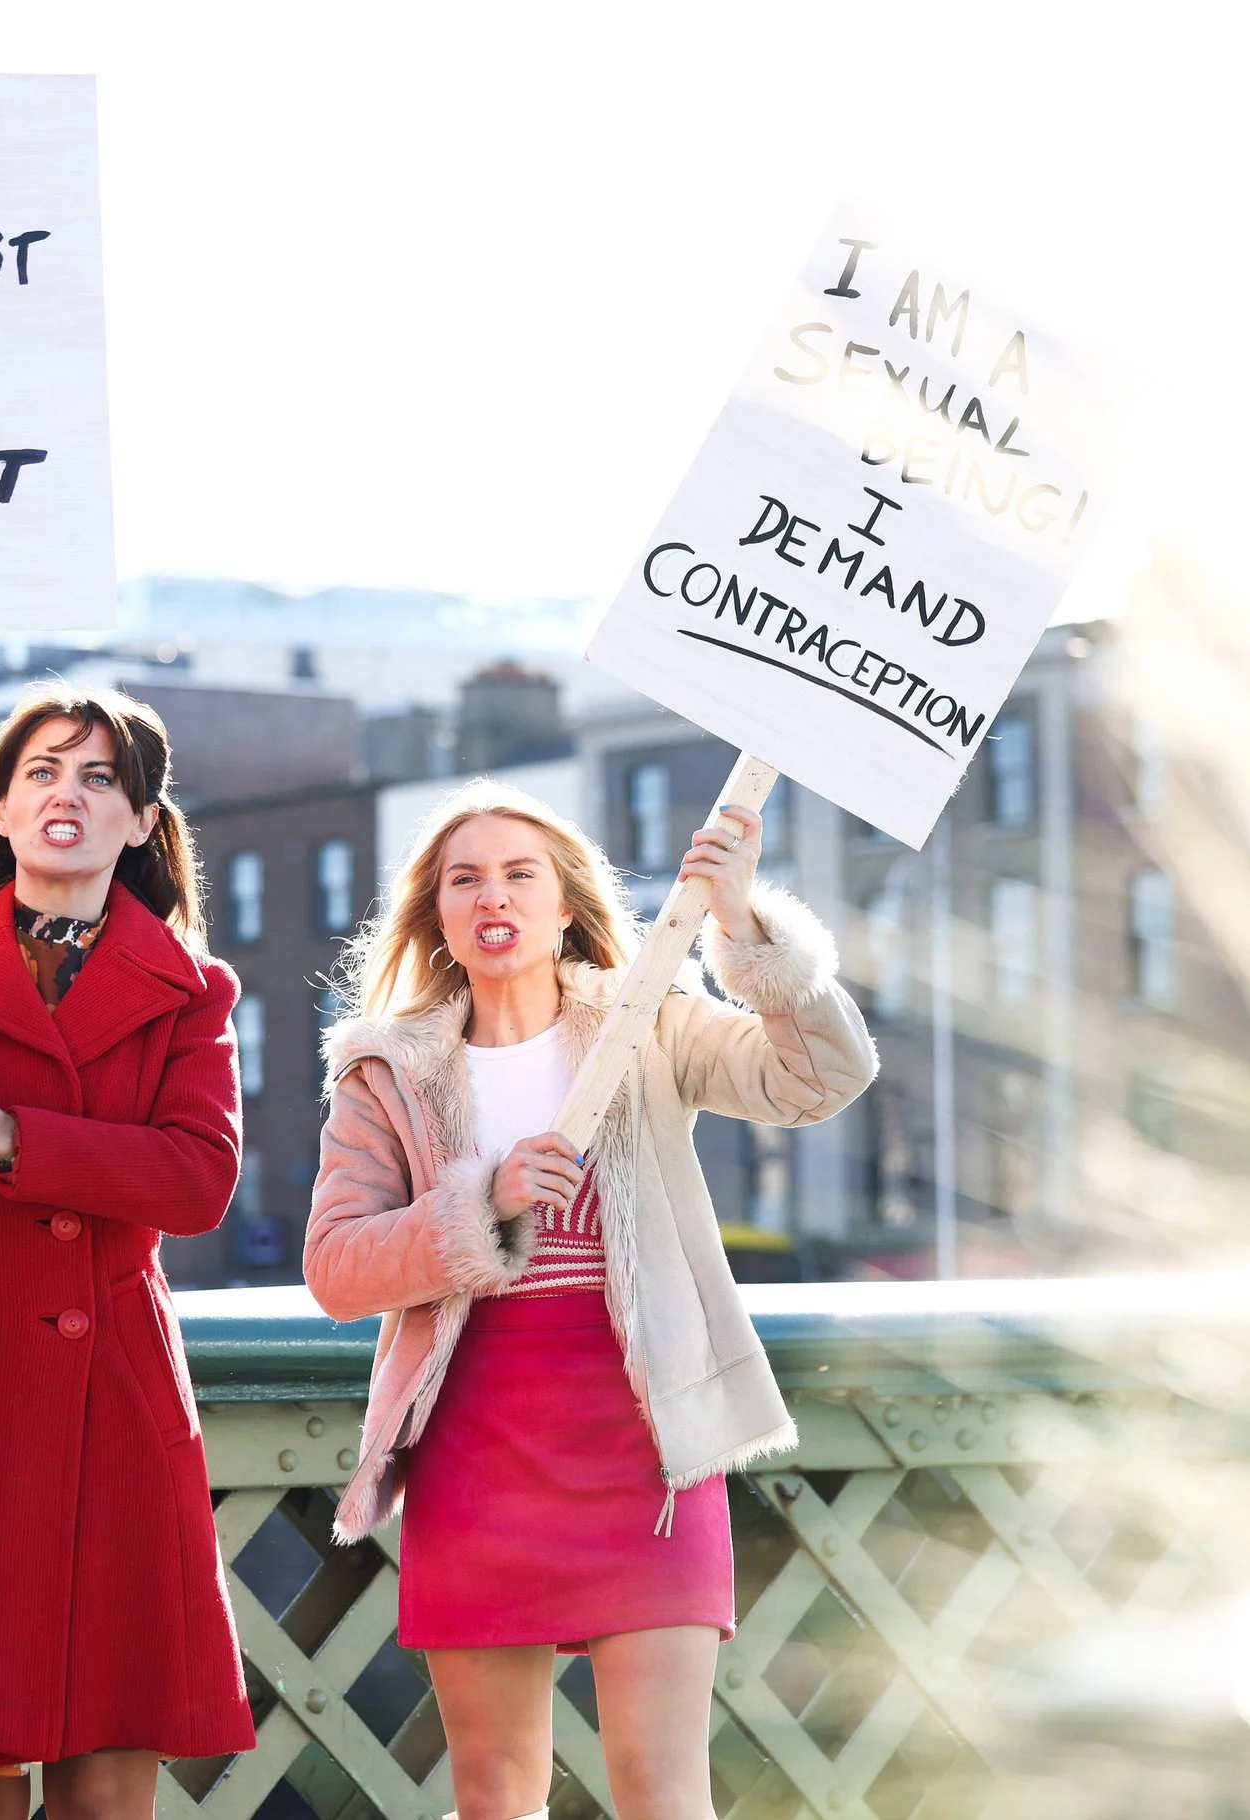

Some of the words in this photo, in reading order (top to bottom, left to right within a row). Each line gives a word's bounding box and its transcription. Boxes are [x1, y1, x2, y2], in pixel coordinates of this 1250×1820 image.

[773, 322, 1031, 457] SEXUAL
[824, 238, 876, 298] I
[889, 268, 970, 357] AM
[988, 329, 1031, 396] A
[739, 495, 985, 646] DEMAND
[848, 487, 902, 546] I
[644, 543, 985, 746] CONTRACEPTION
